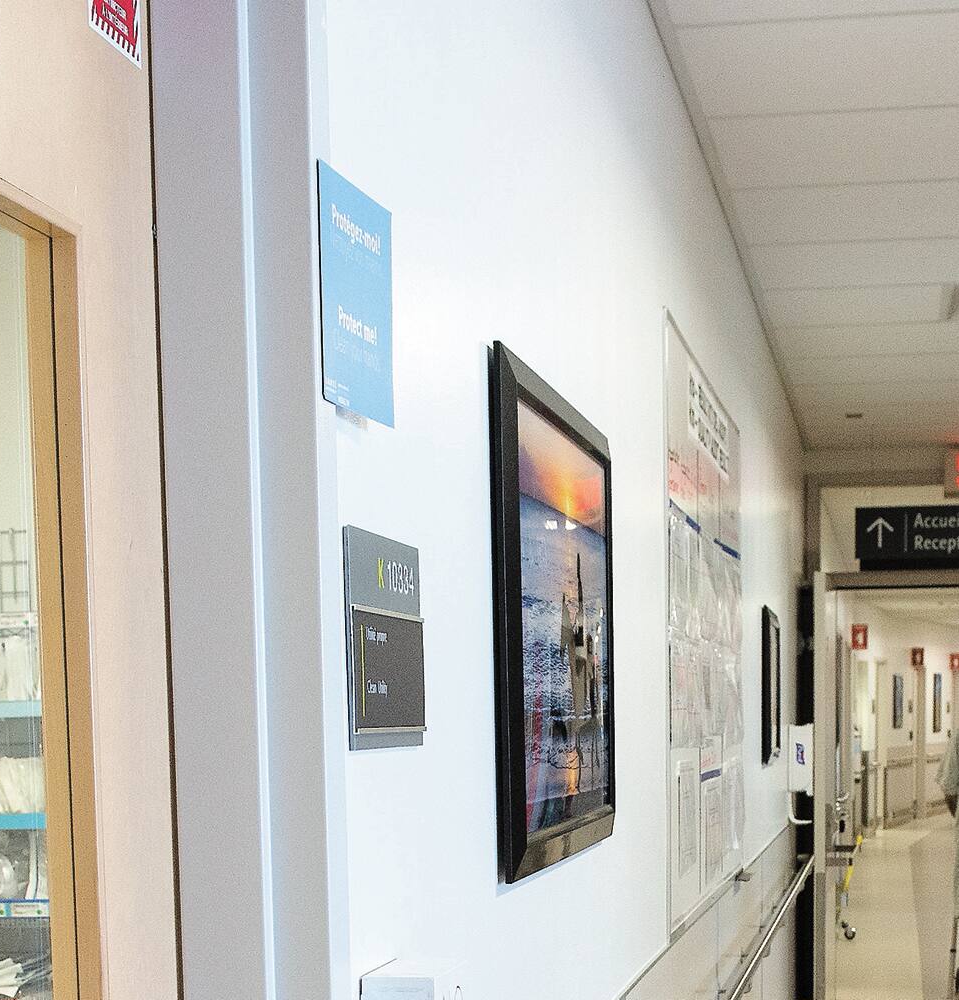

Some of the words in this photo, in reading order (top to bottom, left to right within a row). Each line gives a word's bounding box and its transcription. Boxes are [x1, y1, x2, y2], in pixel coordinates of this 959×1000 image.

[331, 203, 380, 256] Protégez-moi!
[338, 304, 363, 338] Protect
[363, 324, 377, 346] me!
[377, 557, 385, 589] K
[387, 560, 415, 597] 10334
